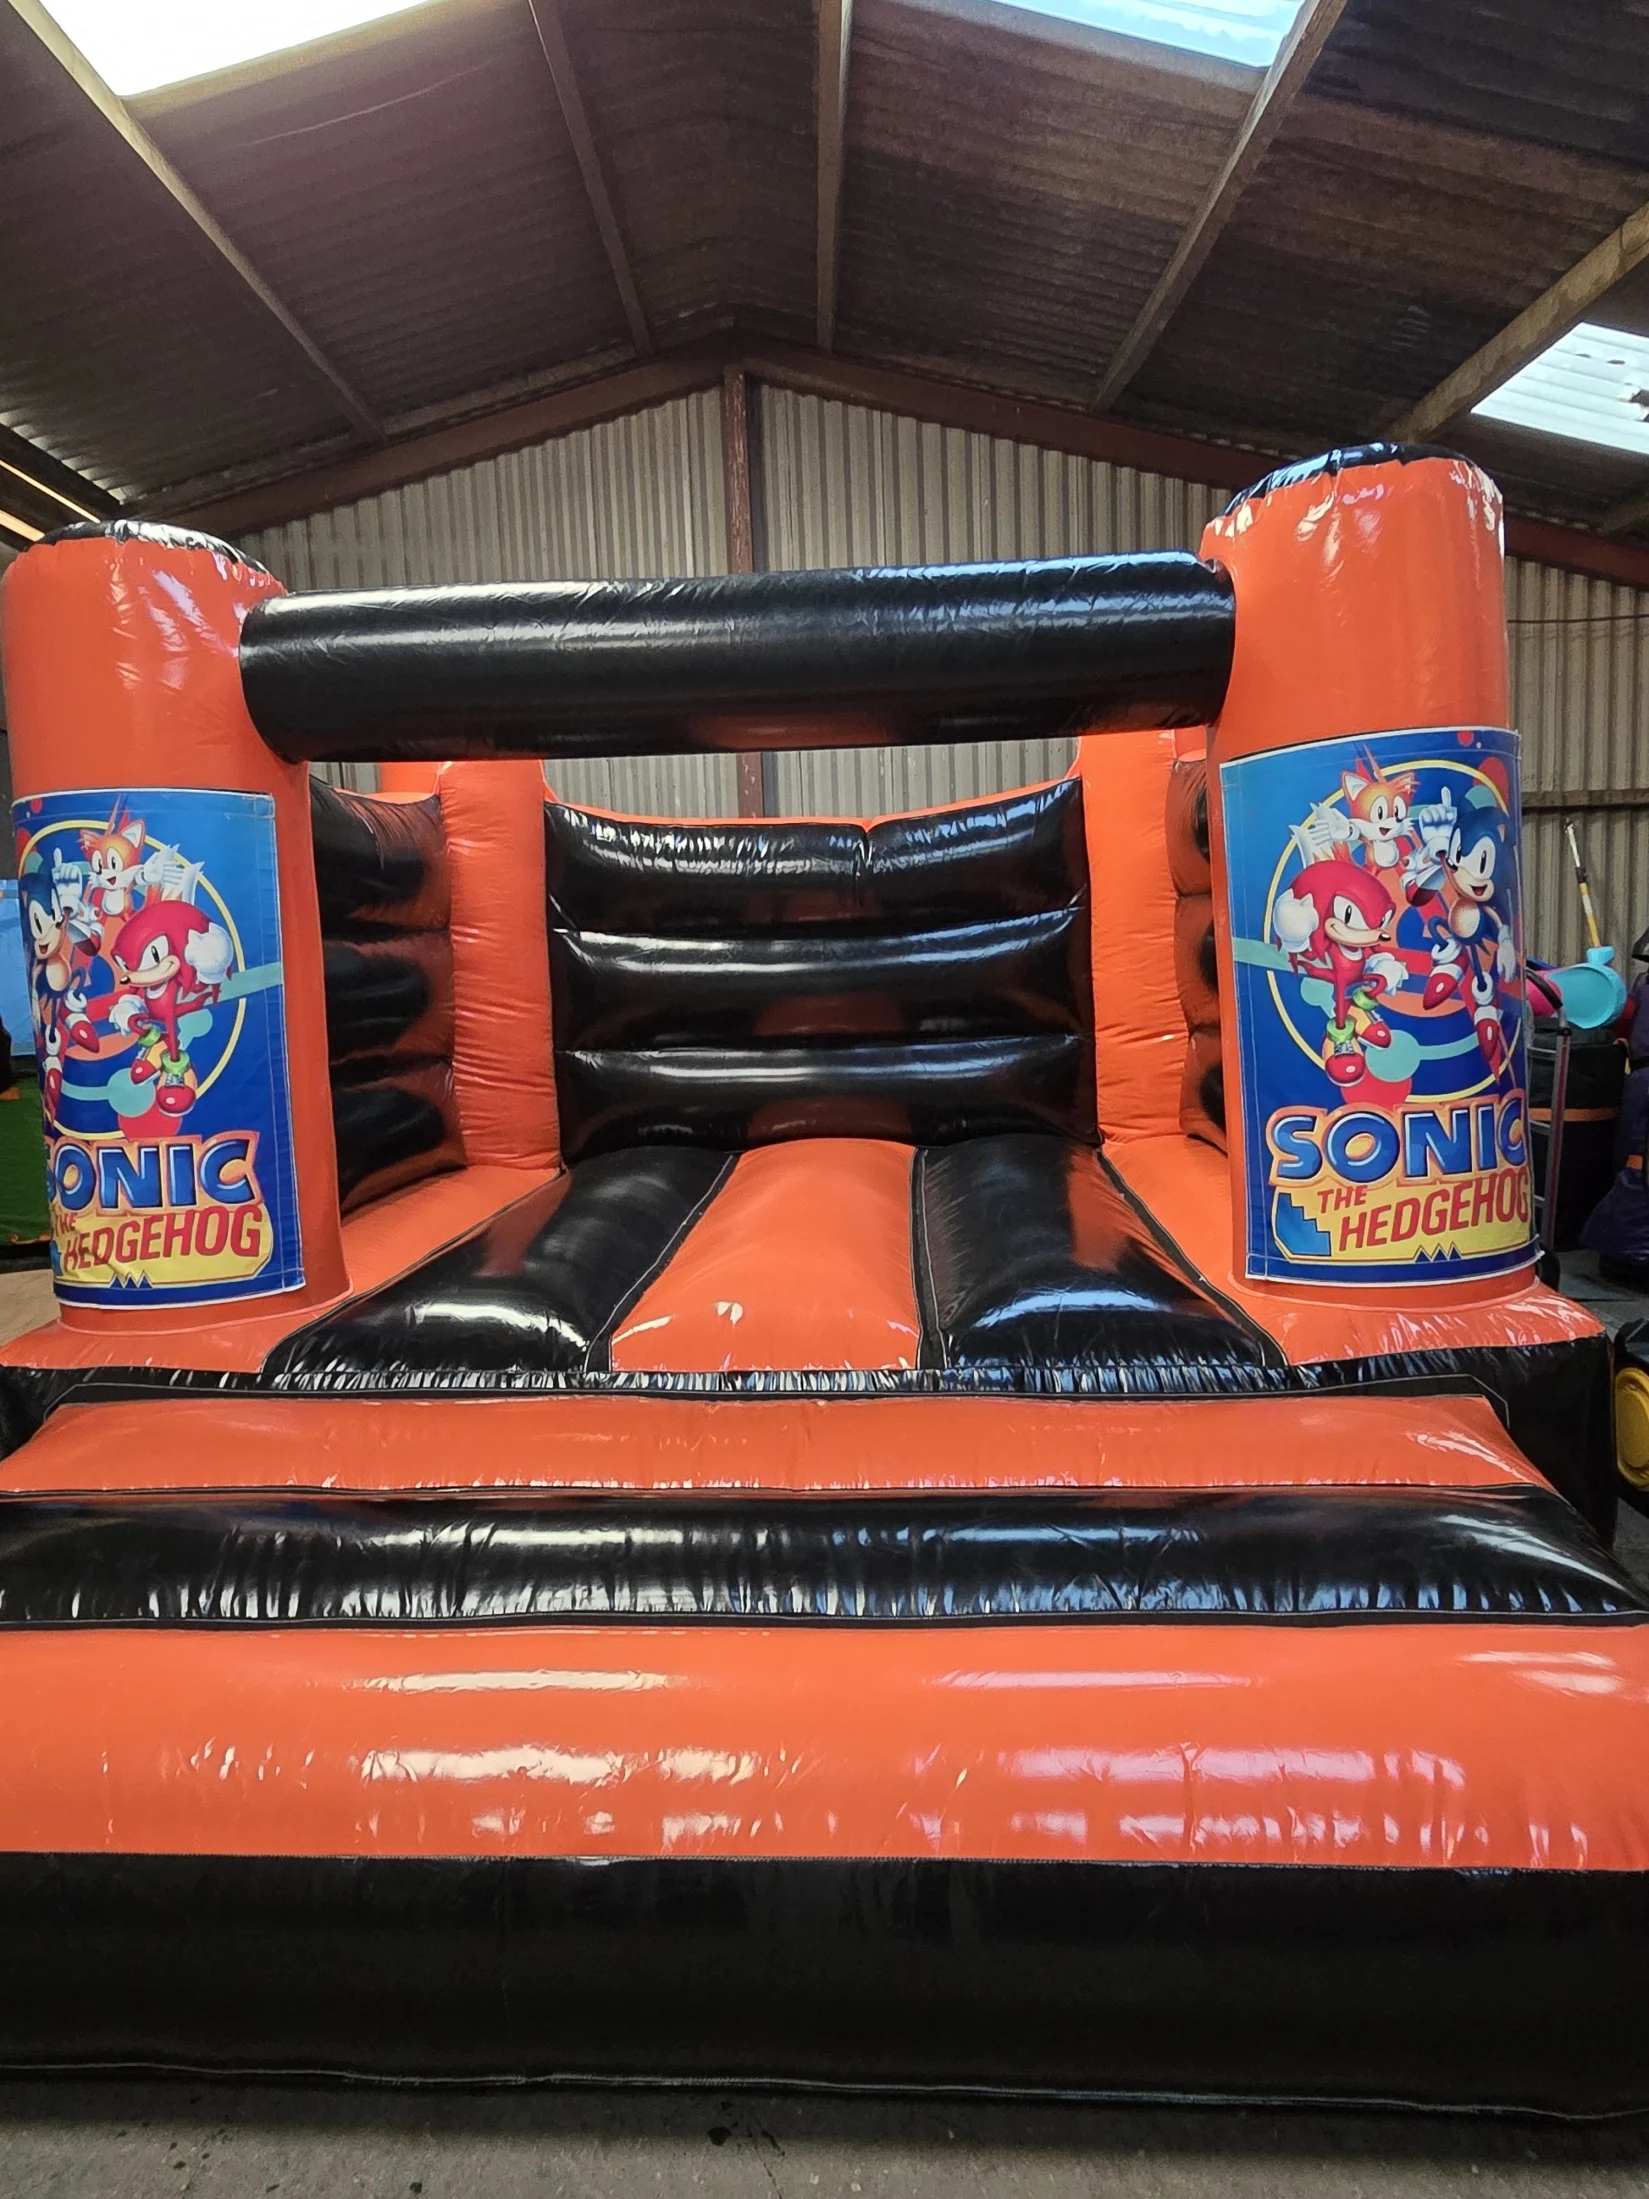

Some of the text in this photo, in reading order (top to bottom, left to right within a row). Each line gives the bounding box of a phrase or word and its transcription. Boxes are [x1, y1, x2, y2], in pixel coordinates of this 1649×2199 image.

[45, 1139, 256, 1210] ONIC
[1271, 1097, 1527, 1183] SONIC
[1317, 1184, 1368, 1214] THE
[1339, 1167, 1529, 1252] HEDGEHOG
[63, 1204, 263, 1271] HEDGEHOG
